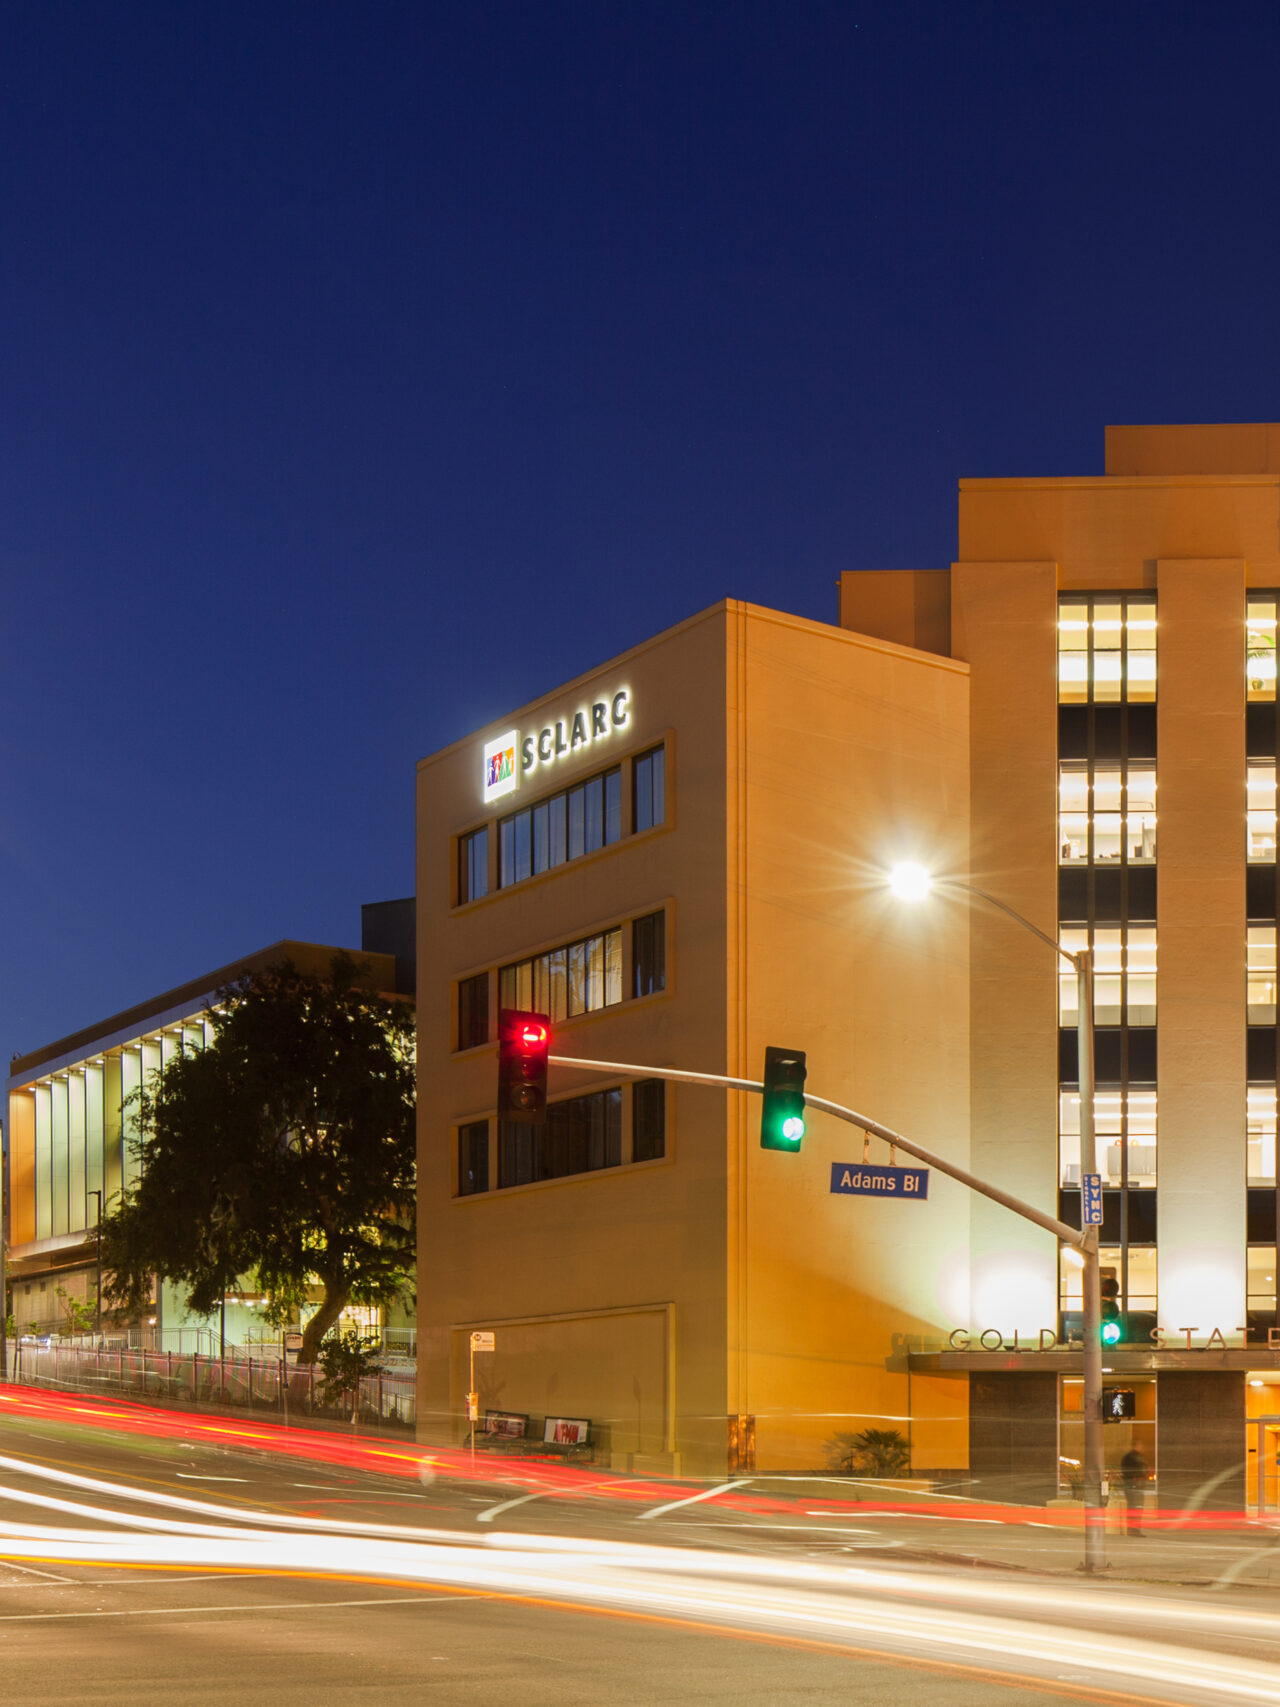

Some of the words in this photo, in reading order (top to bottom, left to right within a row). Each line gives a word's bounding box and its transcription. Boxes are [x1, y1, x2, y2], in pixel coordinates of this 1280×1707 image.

[521, 691, 627, 771] SCLARC
[840, 1170, 896, 1191] Adams
[903, 1174, 920, 1192] Bl
[1090, 1176, 1101, 1222] SYNC
